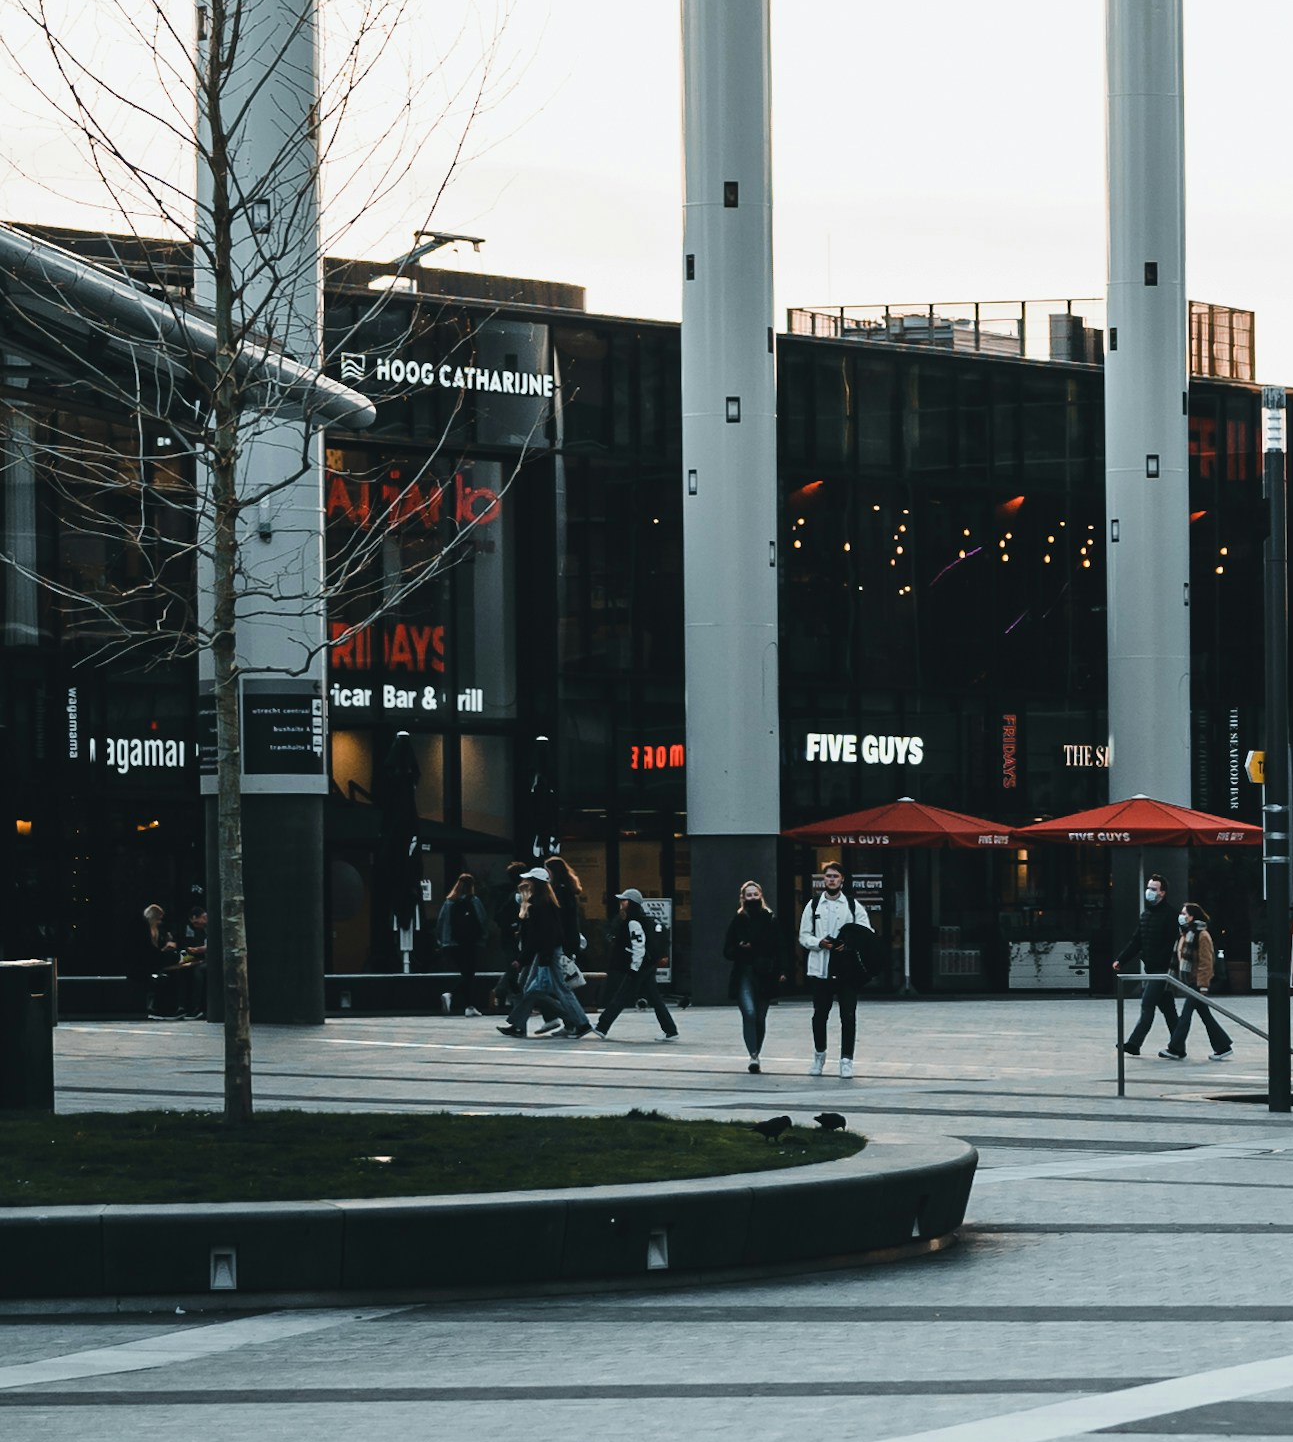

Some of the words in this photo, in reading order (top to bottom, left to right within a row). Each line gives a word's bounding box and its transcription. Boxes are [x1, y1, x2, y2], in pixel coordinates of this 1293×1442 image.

[376, 358, 434, 386] HOOG
[439, 365, 553, 397] CATHARIJNE
[383, 684, 417, 708] Bar
[422, 686, 437, 710] &
[66, 686, 78, 759] wagamama
[806, 732, 857, 763] FIVE
[862, 734, 924, 765] GUYS
[1002, 714, 1017, 789] FRIDAYS
[1063, 744, 1092, 767] THE
[830, 835, 855, 844] FIVE
[858, 835, 890, 845] GUYS
[1068, 832, 1095, 842] FIVE
[1097, 832, 1131, 842] GUYS
